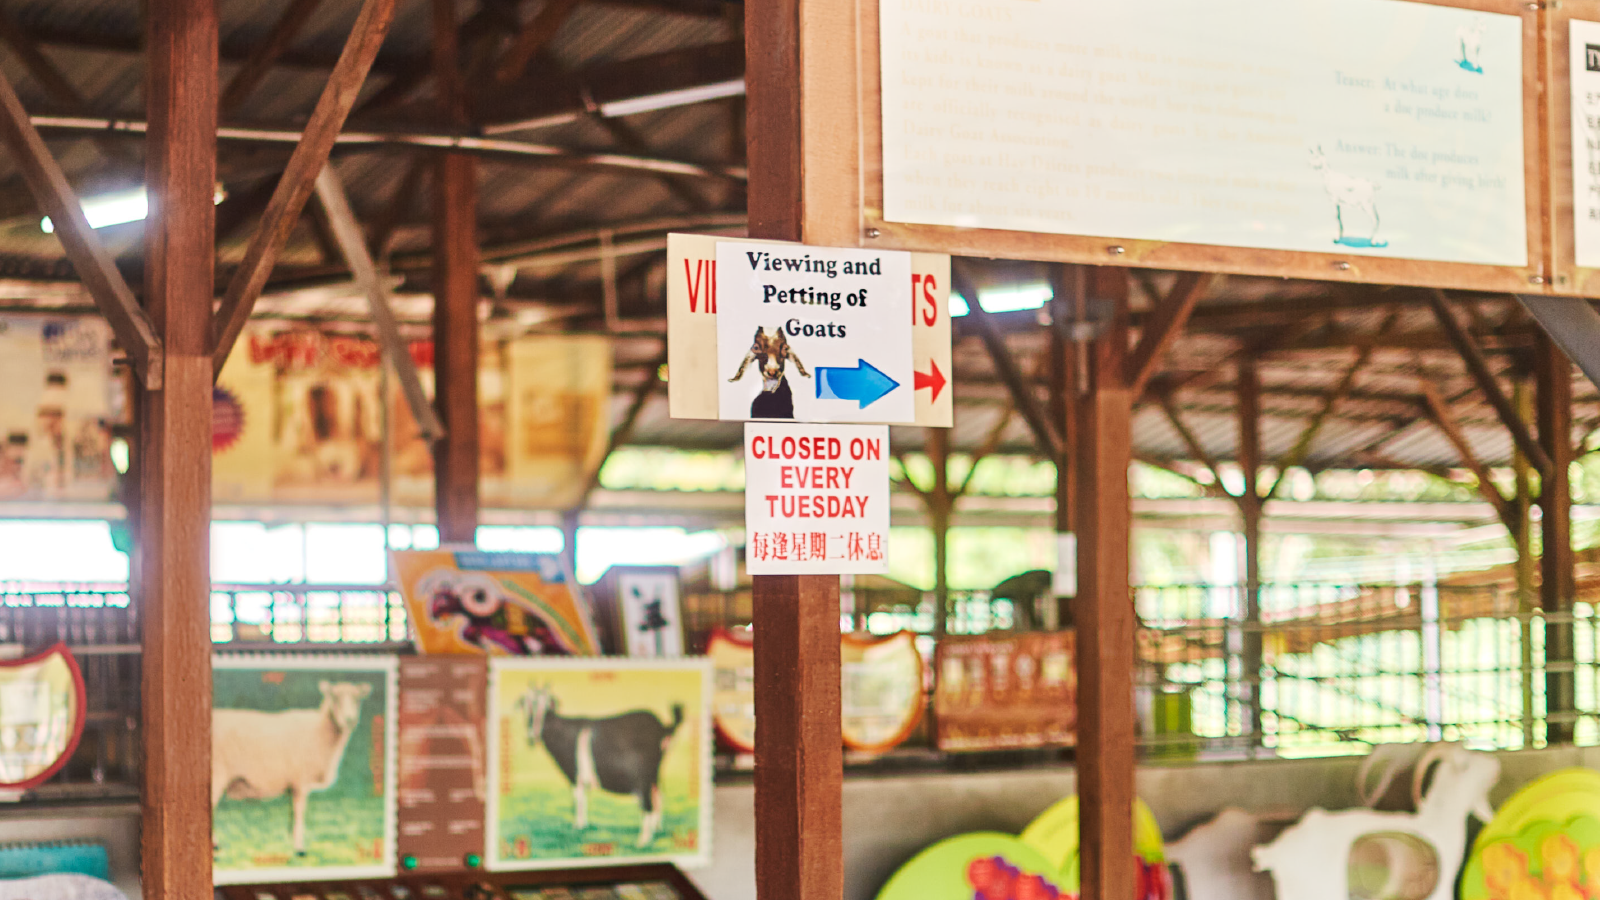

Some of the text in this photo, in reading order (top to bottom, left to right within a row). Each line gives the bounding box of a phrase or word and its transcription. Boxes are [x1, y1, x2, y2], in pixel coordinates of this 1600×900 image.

[746, 251, 882, 279] Viewing and
[763, 284, 868, 311] Petting of
[785, 318, 847, 338] Goats
[752, 435, 880, 460] CLOSED ON
[780, 465, 854, 489] EVERY
[765, 495, 869, 518] TUESDAY
[752, 531, 883, 562] 每逢星期二休息
